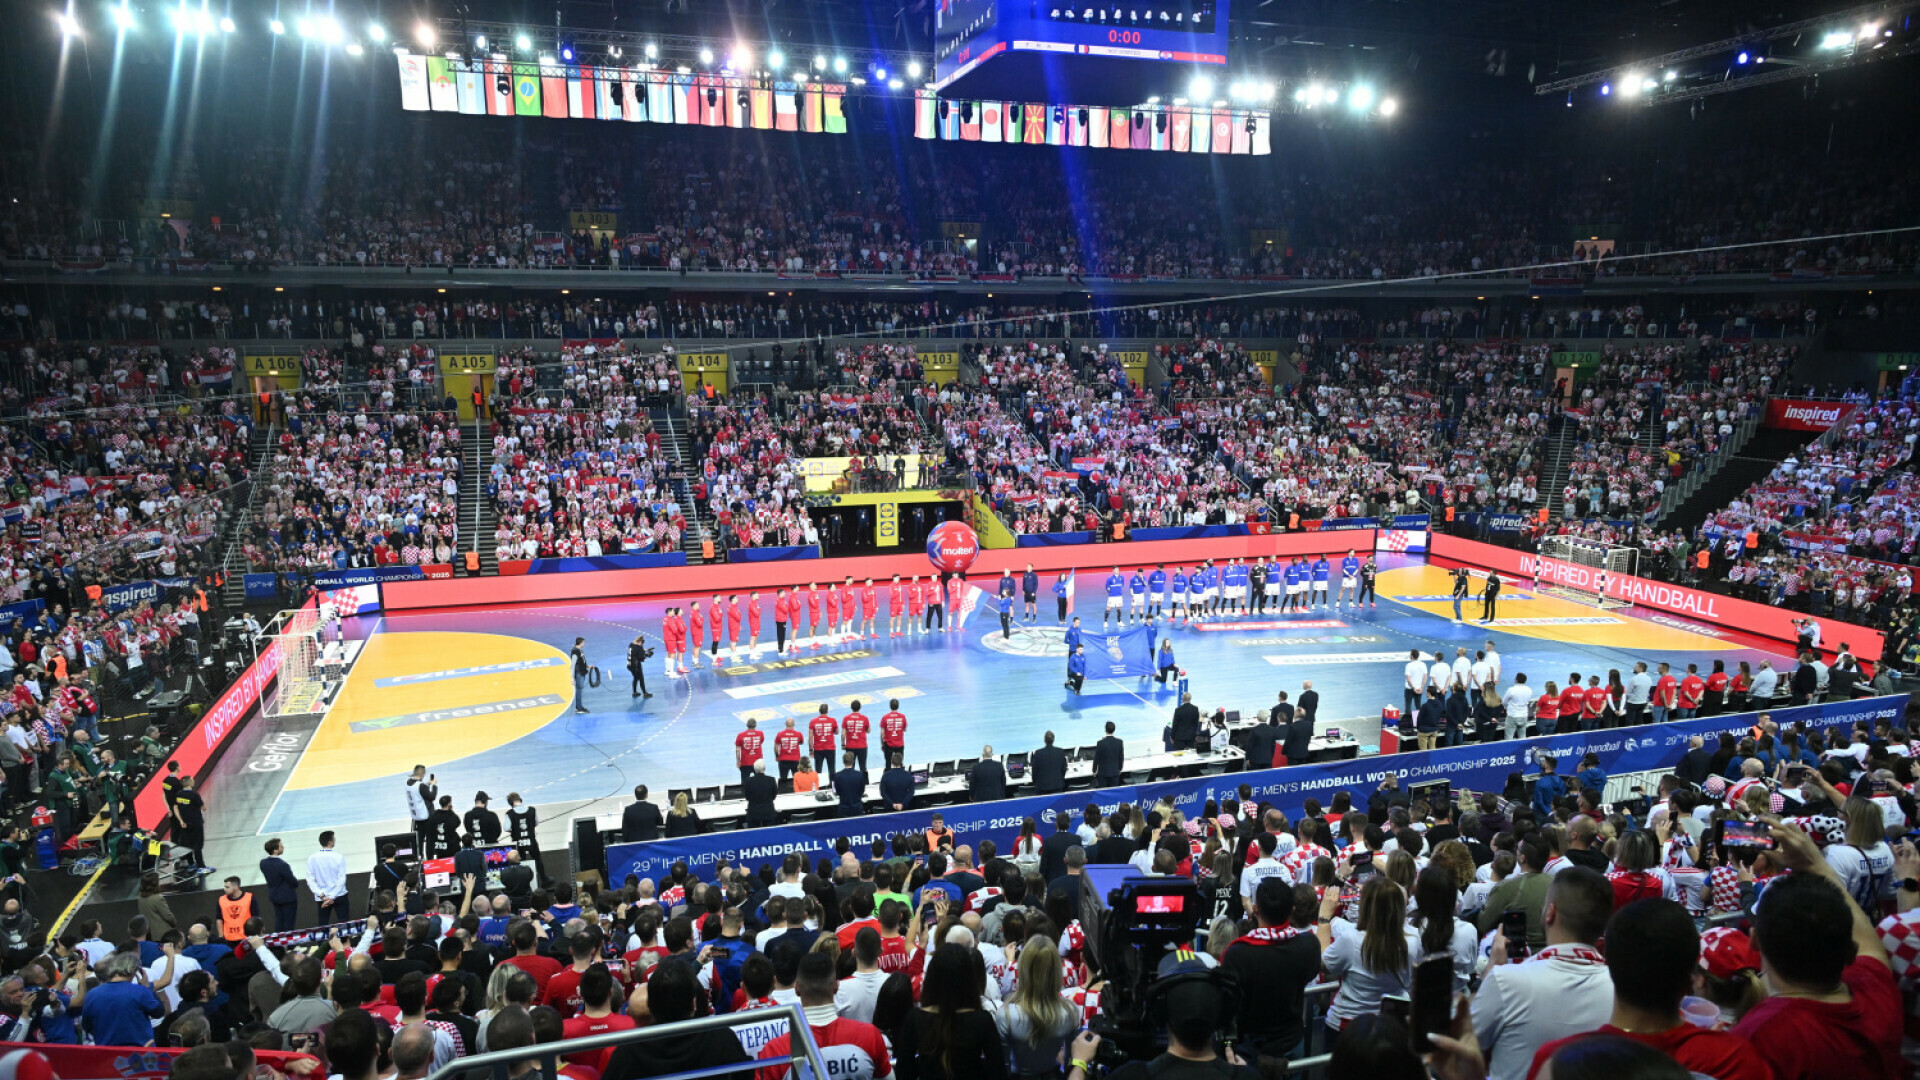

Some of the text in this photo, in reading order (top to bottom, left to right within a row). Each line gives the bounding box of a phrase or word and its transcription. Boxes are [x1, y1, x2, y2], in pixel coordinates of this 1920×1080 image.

[1108, 29, 1141, 45] 0:00
[578, 215, 609, 225] A 303
[255, 357, 295, 369] A 106
[449, 356, 487, 368] A 105
[686, 355, 720, 366] A 104
[922, 354, 952, 365] A 103
[1123, 352, 1142, 363] 102
[1254, 352, 1272, 362] 101
[1558, 352, 1592, 363] D 120
[1784, 404, 1841, 422] inspired
[942, 547, 974, 555] molten
[346, 576, 375, 584] WORLD
[431, 571, 450, 579] 2025
[1521, 556, 1590, 586] INSPIRED
[1620, 579, 1719, 618] HANDBALL
[105, 585, 157, 606] nspired
[1650, 615, 1724, 637] Gerflor
[1237, 635, 1377, 646] waipu tv
[764, 650, 870, 669] HARTING
[203, 690, 244, 749] INSPIRED
[243, 677, 257, 704] BY
[416, 694, 556, 723] freenet
[1814, 711, 1876, 726] CHAMPIONSHIP
[1876, 708, 1897, 718] 2025
[248, 732, 302, 774] Gerflor
[1575, 746, 1587, 755] by
[1262, 781, 1299, 796] MEN'S
[1300, 774, 1364, 791] HANDBALL
[1411, 758, 1488, 777] CHAMPIONSHIP
[1489, 754, 1516, 768] 2025
[1142, 798, 1154, 810] by
[632, 857, 661, 873] 29TH
[689, 850, 736, 866] MEN'S
[739, 840, 823, 860] HANDBALL
[826, 832, 882, 850] WRLD
[989, 816, 1024, 829] 2025
[1213, 899, 1229, 918] 12
[486, 933, 508, 942] FRANC
